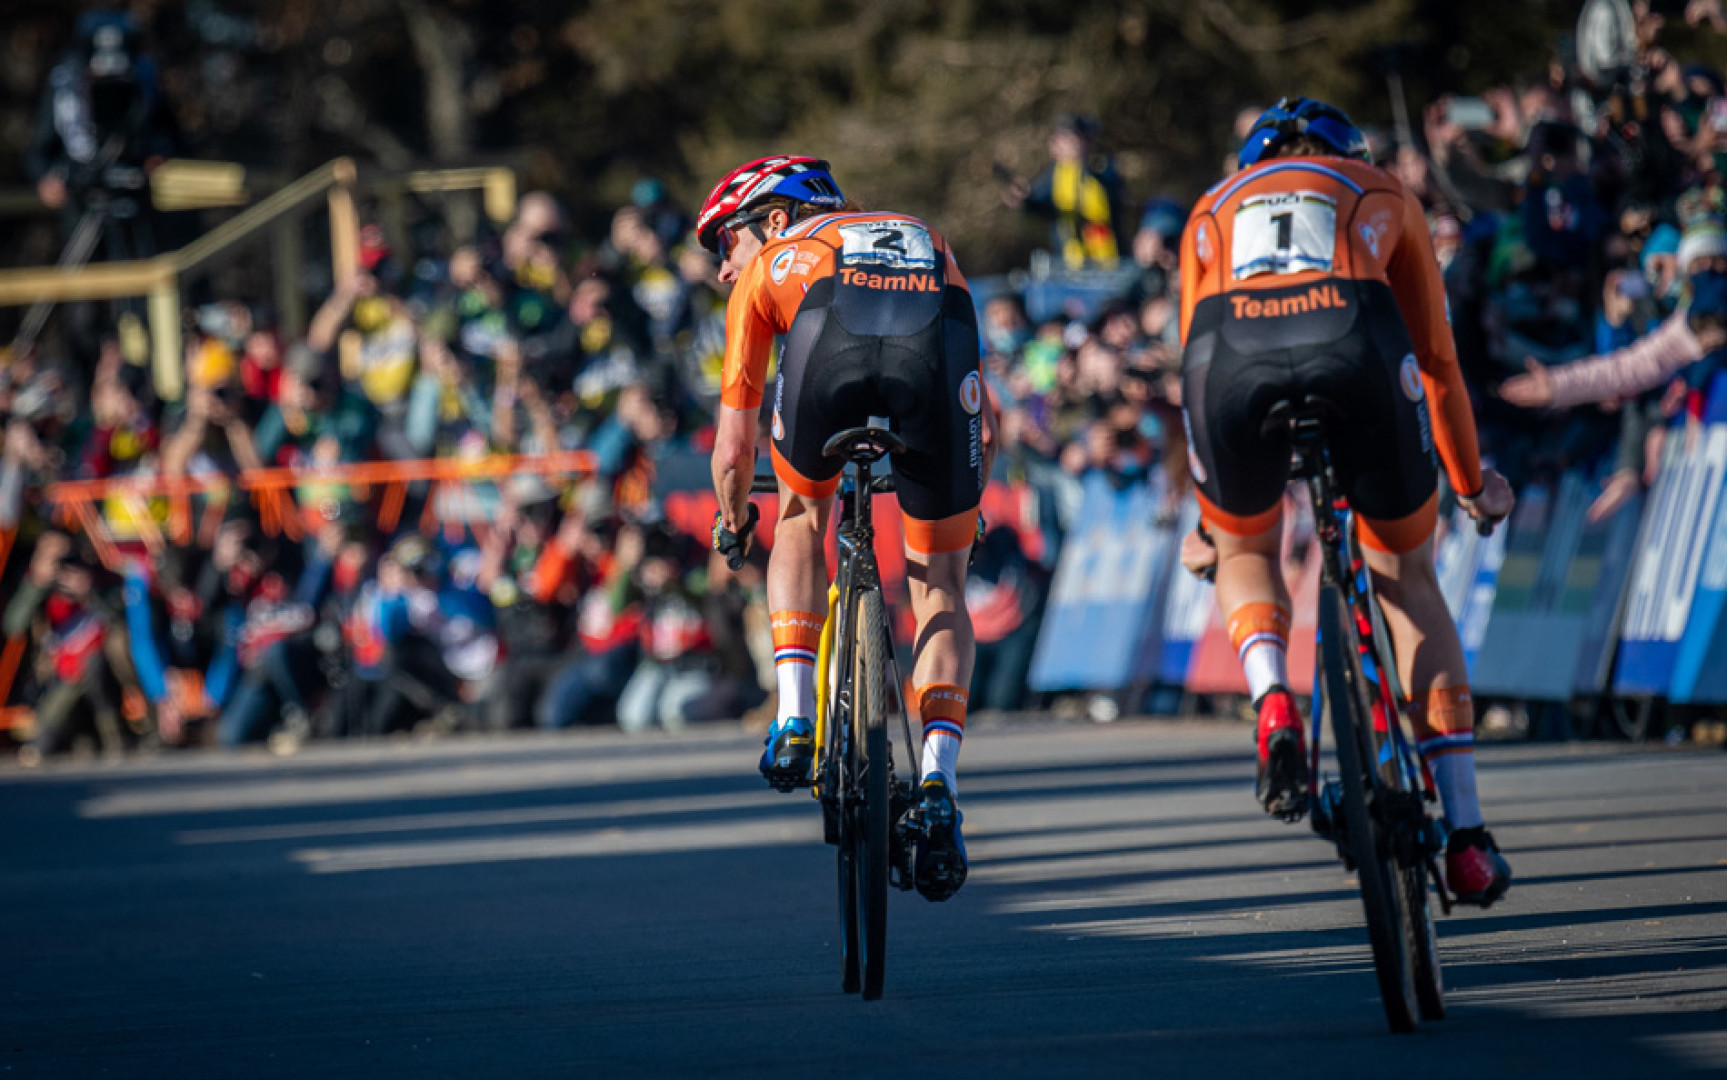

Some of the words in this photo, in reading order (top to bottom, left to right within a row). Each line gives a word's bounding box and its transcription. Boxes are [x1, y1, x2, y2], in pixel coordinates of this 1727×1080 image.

[868, 228, 907, 255] 2
[1270, 212, 1293, 250] 1
[839, 267, 941, 292] TeamNL
[1231, 285, 1347, 319] TeamNL
